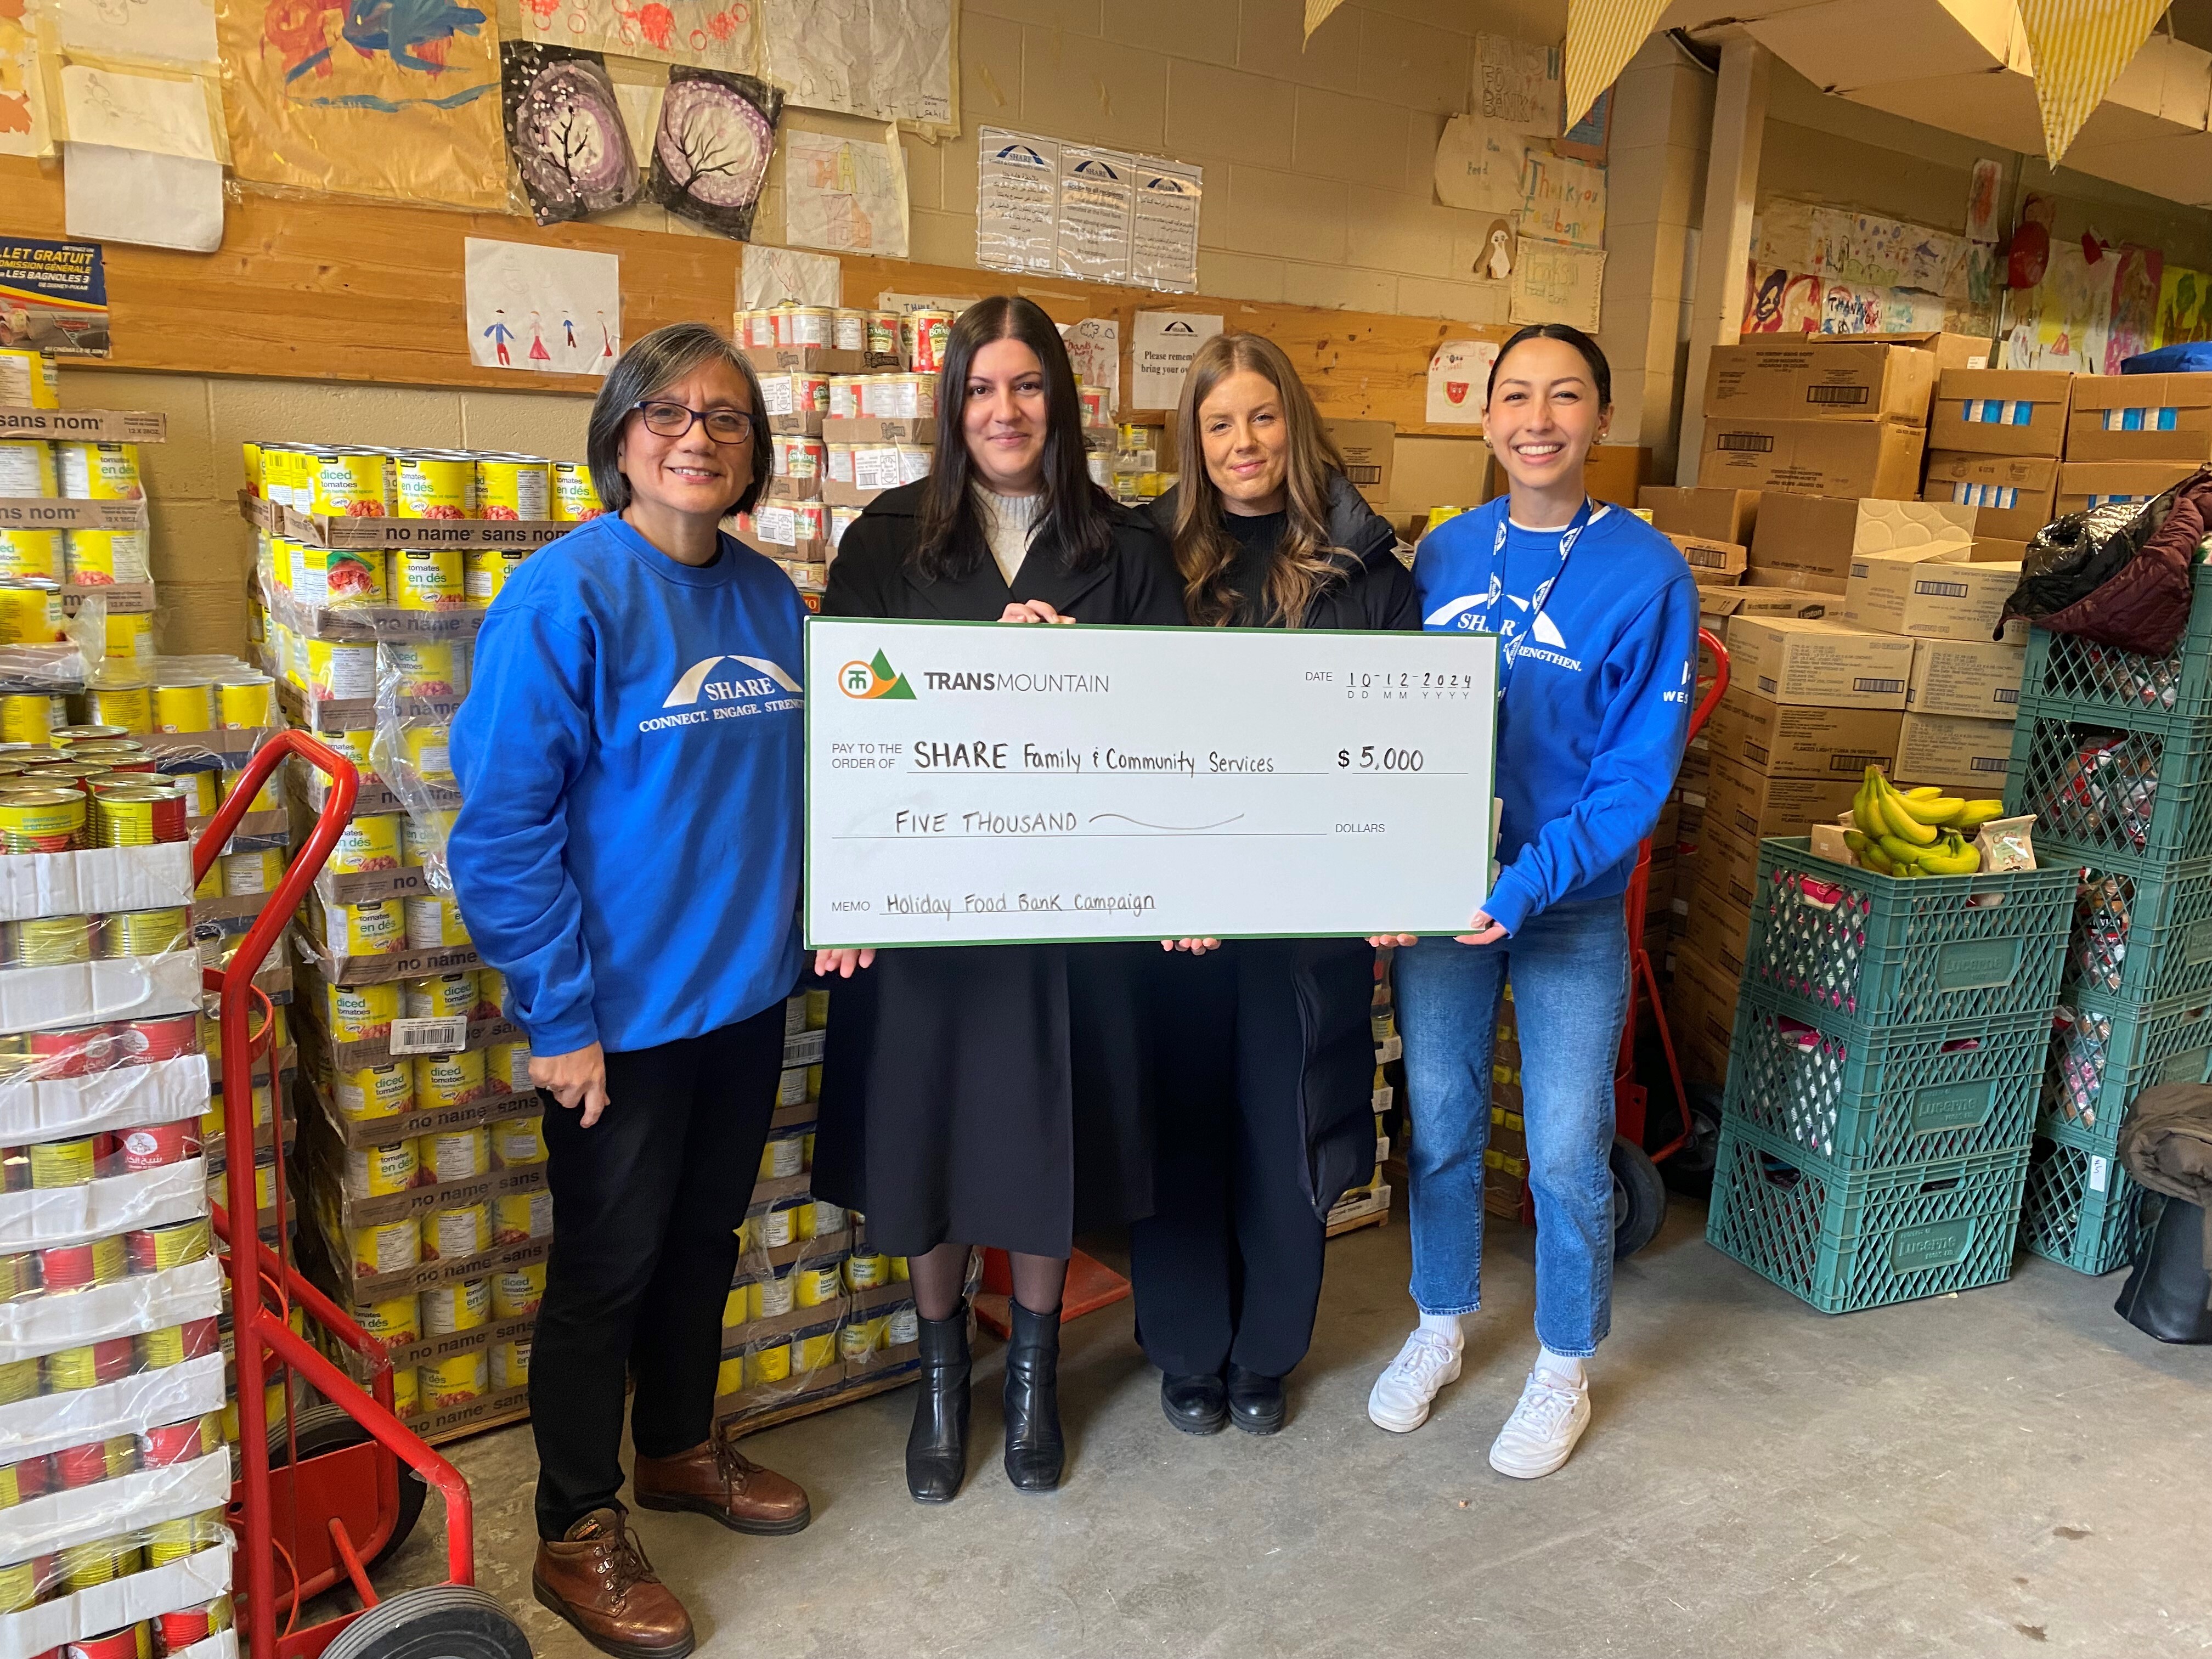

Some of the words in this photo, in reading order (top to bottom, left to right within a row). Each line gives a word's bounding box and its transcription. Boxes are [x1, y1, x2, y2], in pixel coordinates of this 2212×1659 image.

[33, 249, 94, 264] GRATUIT
[44, 263, 92, 274] GÉNÉRALE
[6, 270, 26, 279] LES
[27, 272, 81, 283] BAGNOLES
[83, 275, 90, 283] 3
[1144, 351, 1166, 360] Please
[1168, 353, 1195, 362] remem
[1141, 364, 1161, 375] bring
[1163, 366, 1180, 375] your
[0, 415, 46, 428] sans
[53, 416, 99, 430] nom
[320, 470, 352, 480] diced
[402, 483, 411, 492] en
[415, 479, 434, 492] dés
[556, 486, 568, 495] en
[571, 485, 590, 496] dés
[330, 498, 348, 506] Simply
[30, 508, 76, 520] nom
[386, 527, 411, 540] no
[417, 527, 471, 541] name
[482, 528, 526, 541] sans
[408, 564, 439, 572] tomates
[408, 573, 424, 583] en
[426, 571, 447, 583] dés
[1800, 609, 1822, 619] Lipton
[407, 616, 460, 630] name
[924, 672, 1109, 693] TRANSMOUNTAIN
[1305, 671, 1333, 682] DATE
[704, 677, 776, 702] SHARE
[639, 711, 709, 733] CONNECT.
[713, 703, 762, 720] ENGAGE.
[832, 743, 854, 754] PAY
[857, 743, 875, 754] TO
[878, 743, 902, 754] THE
[832, 758, 875, 769] ORDER
[879, 758, 895, 769] OF
[914, 741, 1008, 769] SHARE
[1024, 743, 1081, 774] Family
[1106, 748, 1195, 778] Community
[1209, 751, 1274, 773] Services
[1338, 748, 1350, 769] $
[1359, 745, 1424, 772] 5,000
[895, 809, 949, 833] FIVE
[962, 811, 1077, 834] THOUSAND
[1335, 823, 1385, 834] DOLLARS
[351, 836, 371, 847] dés
[393, 874, 417, 890] no
[831, 901, 871, 912] MEMO
[887, 894, 952, 921] Holiday
[964, 894, 1007, 913] Food
[1019, 894, 1063, 911] Bank
[1074, 894, 1156, 917] Campaign
[359, 913, 390, 922] tomates
[359, 923, 376, 933] en
[379, 920, 396, 932] dés
[397, 956, 421, 972] no
[426, 949, 477, 969] name
[444, 984, 472, 996] diced
[336, 997, 366, 1008] diced
[444, 991, 474, 1003] tomatoes
[431, 1065, 461, 1076] diced
[376, 1075, 404, 1088] diced
[431, 1075, 466, 1084] tomatoes
[376, 1084, 407, 1095] tomatoes
[1919, 1098, 1976, 1116] Lucerne
[409, 1115, 432, 1131] no
[439, 1105, 487, 1125] name
[497, 1097, 539, 1113] sans
[381, 1151, 409, 1163] tomates
[381, 1164, 396, 1173] en
[398, 1159, 414, 1171] dés
[411, 1194, 433, 1208] no
[440, 1183, 489, 1203] name
[499, 1171, 540, 1189] sans
[1899, 1236, 1956, 1257] Lucerne
[416, 1268, 439, 1284] no
[444, 1257, 492, 1278] name
[503, 1245, 542, 1263] sans
[501, 1277, 529, 1286] diced
[467, 1296, 478, 1306] en
[368, 1318, 388, 1328] dés
[409, 1347, 432, 1362] no
[438, 1332, 486, 1355] name
[495, 1320, 535, 1338] sans
[428, 1374, 447, 1384] dés
[436, 1404, 484, 1426] name
